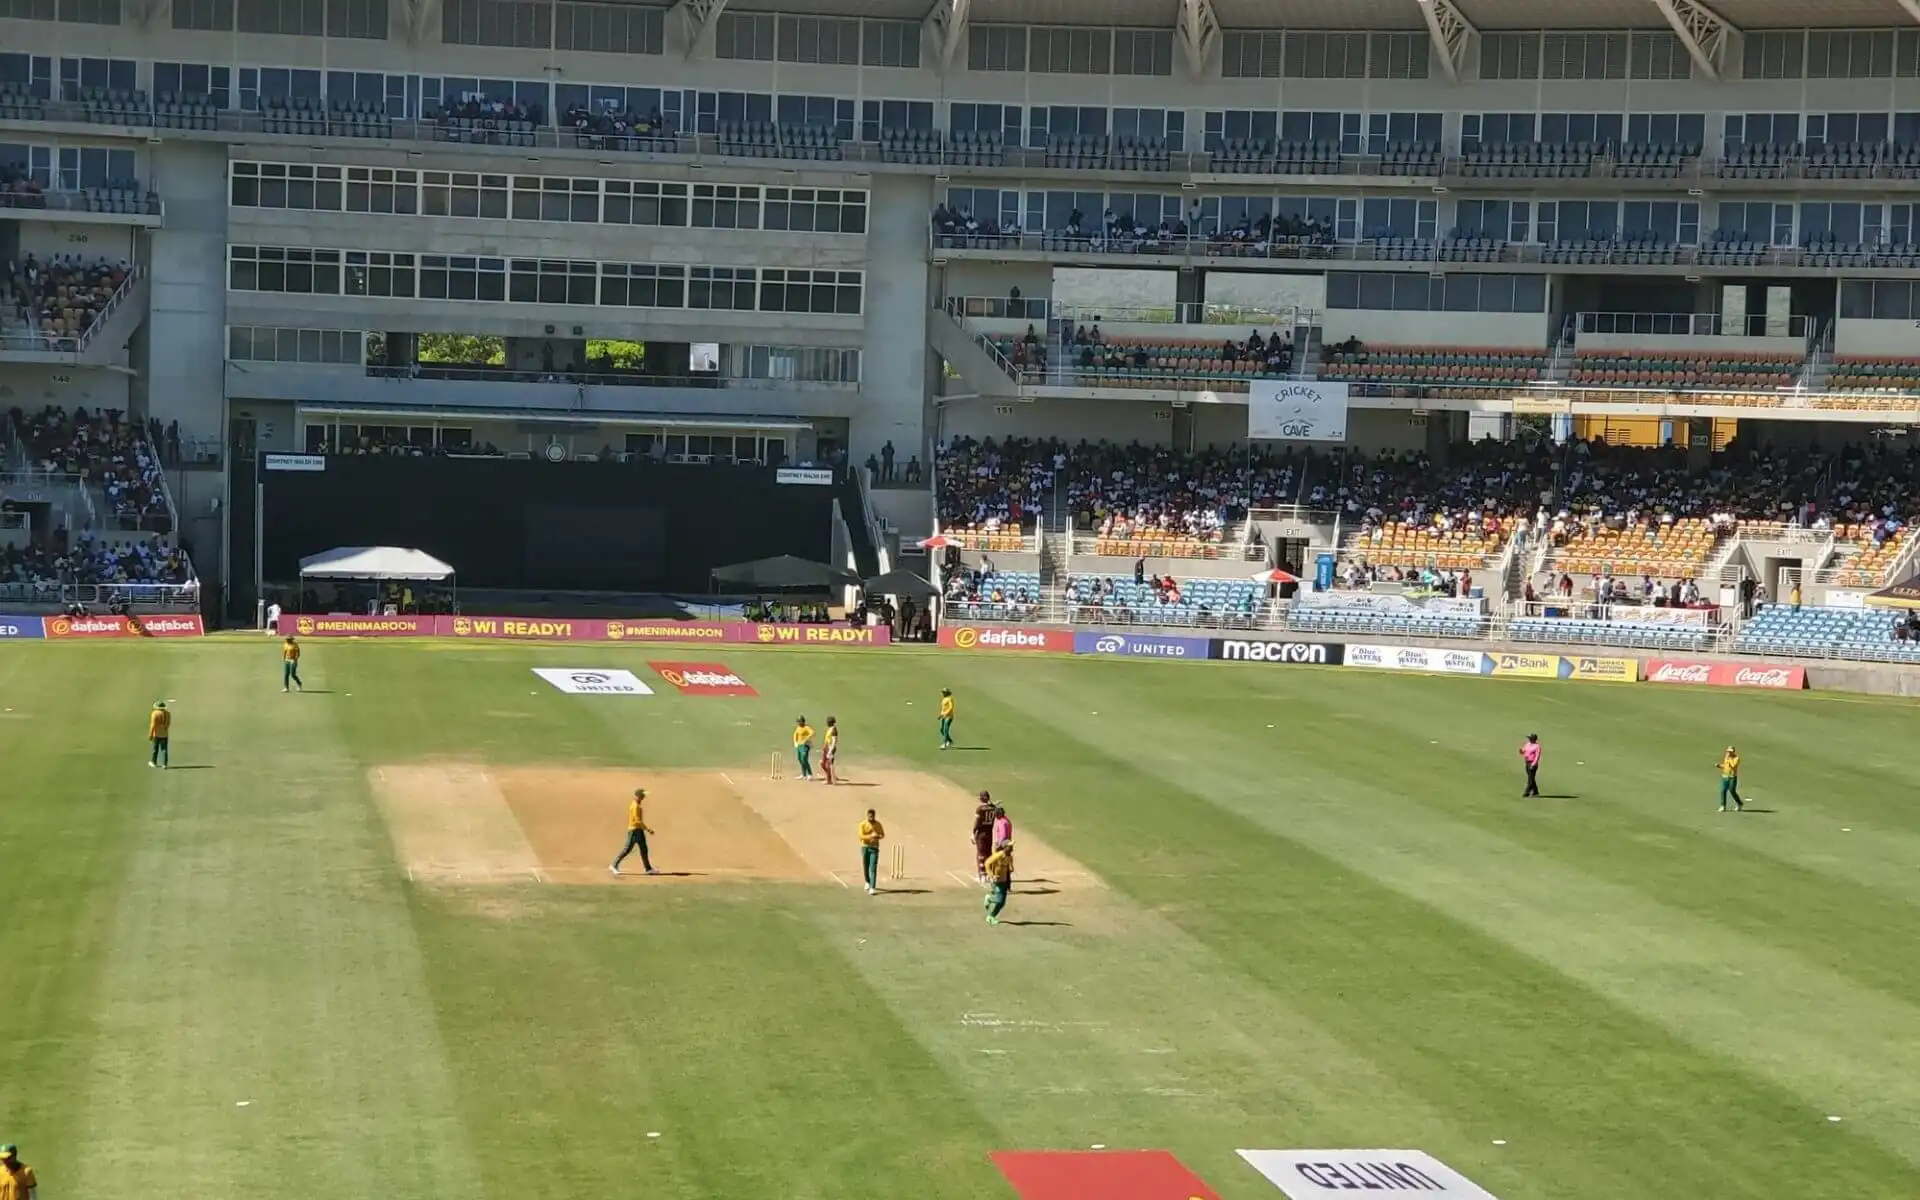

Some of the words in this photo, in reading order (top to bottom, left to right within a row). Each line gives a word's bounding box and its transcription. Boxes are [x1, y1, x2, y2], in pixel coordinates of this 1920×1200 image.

[1274, 386, 1323, 403] CRICKET
[996, 406, 1013, 415] 151
[1153, 411, 1171, 419] 152
[1283, 425, 1311, 437] CAVE
[71, 621, 121, 633] dafabet
[145, 620, 195, 631] dafabet
[316, 621, 417, 632] #MENINMAROON
[474, 620, 497, 634] WI
[503, 621, 572, 636] READY!
[625, 626, 723, 638] #MENINMAROON
[777, 627, 799, 640] WI
[806, 628, 873, 642] READY!
[979, 629, 1046, 647] dafabet
[1133, 643, 1185, 657] UNITED
[1223, 640, 1327, 664] macron
[1519, 657, 1550, 669] Bank
[682, 671, 747, 687] dafabet
[576, 684, 635, 692] UNITED
[1295, 1162, 1447, 1191] UNITED
